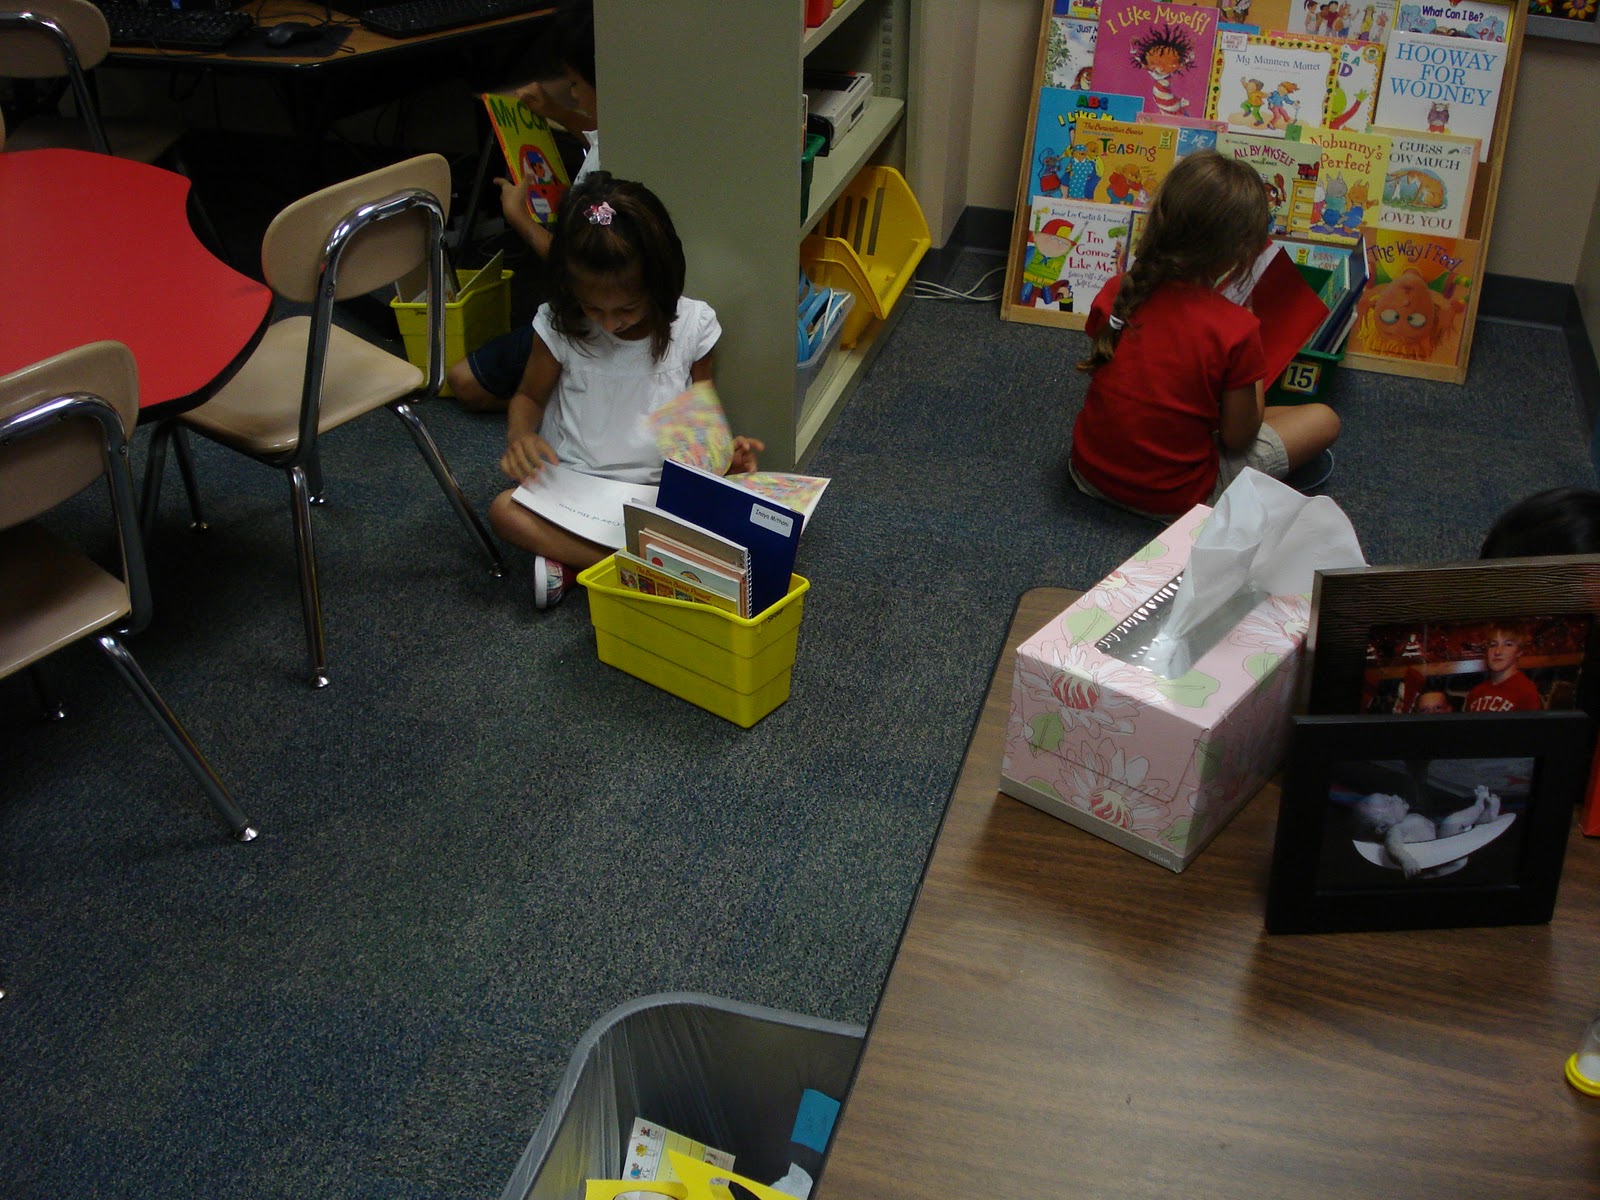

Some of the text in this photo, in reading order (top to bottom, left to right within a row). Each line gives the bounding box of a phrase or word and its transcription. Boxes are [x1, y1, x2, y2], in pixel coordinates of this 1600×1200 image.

[1106, 5, 1211, 36] I Like Myself!
[1422, 5, 1485, 22] What Can I Be?
[1236, 54, 1250, 65] My
[1254, 55, 1290, 67] Manners
[1293, 61, 1320, 71] Matter
[1395, 42, 1498, 71] HOOWAY
[1419, 63, 1466, 85] FOR
[1390, 77, 1492, 106] WODNEY
[1076, 95, 1109, 110] ABC
[490, 99, 519, 136] My
[1057, 115, 1065, 126] I
[1234, 148, 1248, 160] ALL
[1250, 145, 1262, 156] BY
[1261, 145, 1296, 167] MYSELF
[1310, 133, 1383, 160] Nobunny's
[1399, 141, 1443, 155] GUESS
[1320, 153, 1372, 174] Perfect
[1390, 152, 1460, 170] OW MUCH
[1381, 211, 1453, 229] OVE YOU
[1087, 231, 1104, 244] I'm
[1075, 244, 1110, 258] Gonna
[1366, 240, 1462, 271] The Way I Feel
[1069, 256, 1113, 273] Like Me
[1288, 366, 1314, 388] 15
